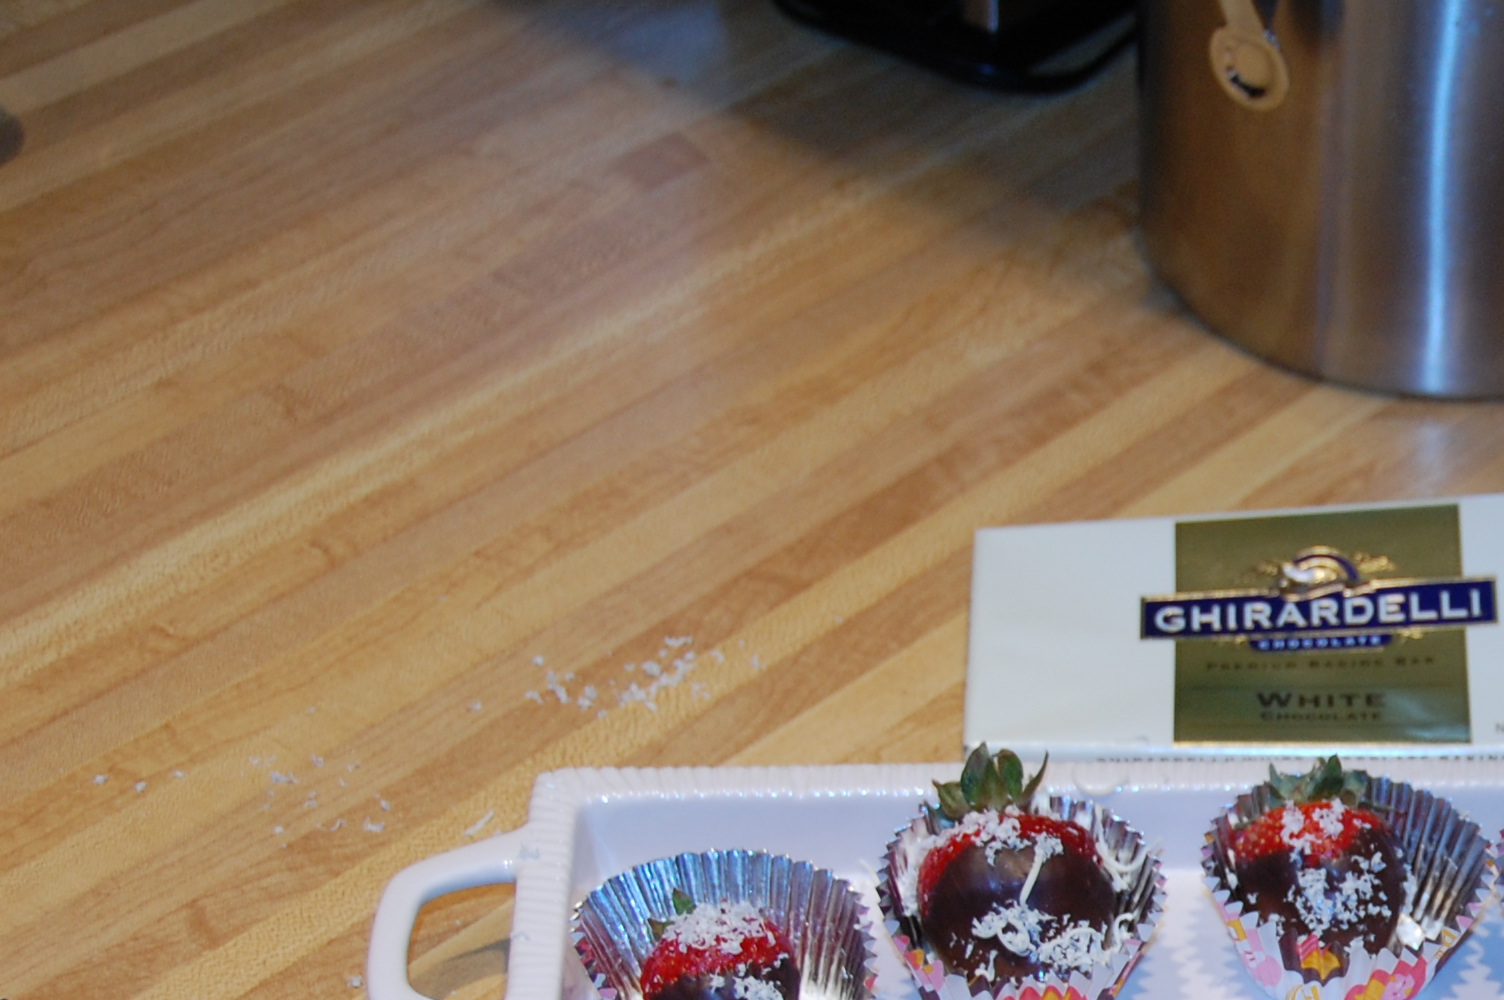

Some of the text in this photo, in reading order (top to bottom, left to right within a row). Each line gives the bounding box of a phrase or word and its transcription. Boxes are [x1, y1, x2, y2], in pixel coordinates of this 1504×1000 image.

[1153, 588, 1483, 633] GHIRARDELLI
[1257, 634, 1383, 650] CHOCOLATE
[1256, 691, 1386, 708] WHITE
[1259, 711, 1383, 722] CHOCOLATE
